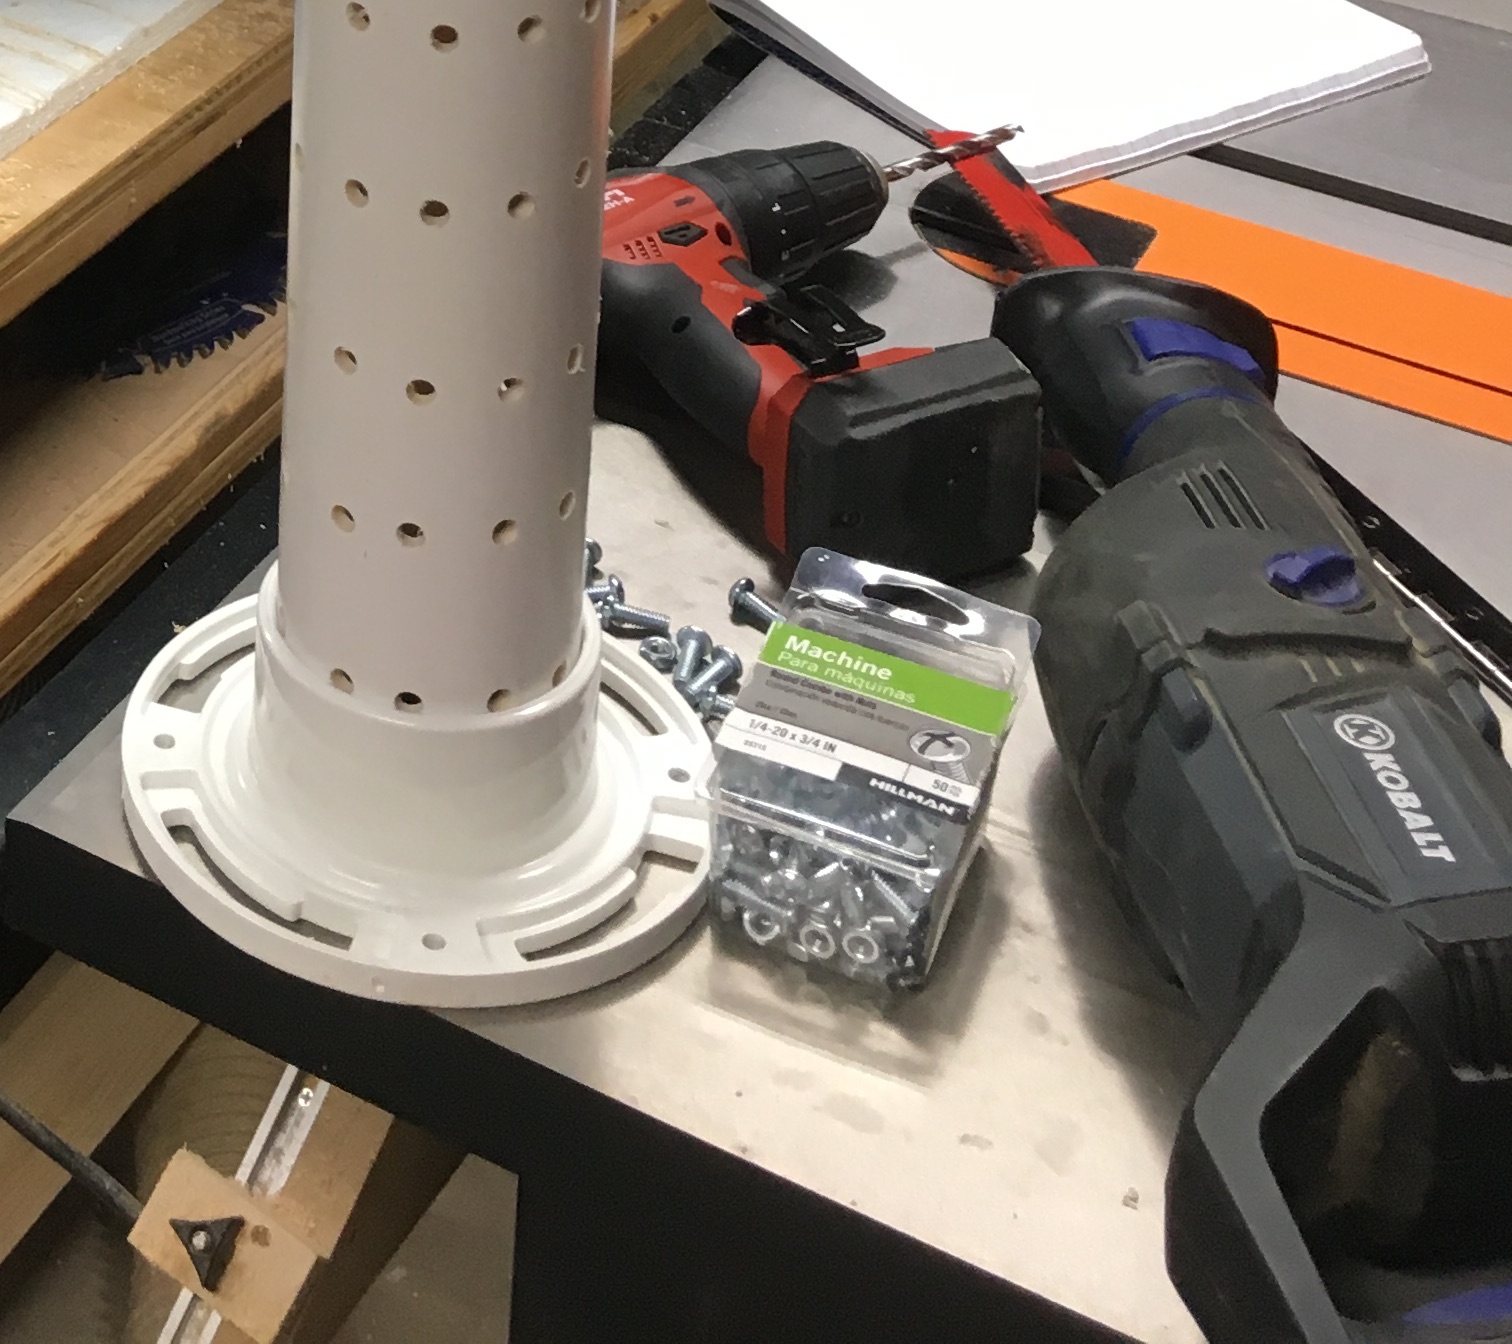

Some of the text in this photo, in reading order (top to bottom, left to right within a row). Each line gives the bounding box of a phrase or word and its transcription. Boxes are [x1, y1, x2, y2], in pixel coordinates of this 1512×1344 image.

[778, 651, 819, 673] Para
[824, 666, 916, 704] máquinas
[784, 635, 892, 681] Machine
[748, 718, 789, 738] 1/4-20
[799, 733, 821, 750] 3/4
[822, 741, 838, 754] IN
[869, 777, 955, 817] HILLMAN
[931, 778, 949, 793] 50
[1362, 752, 1457, 863] KOBALT
